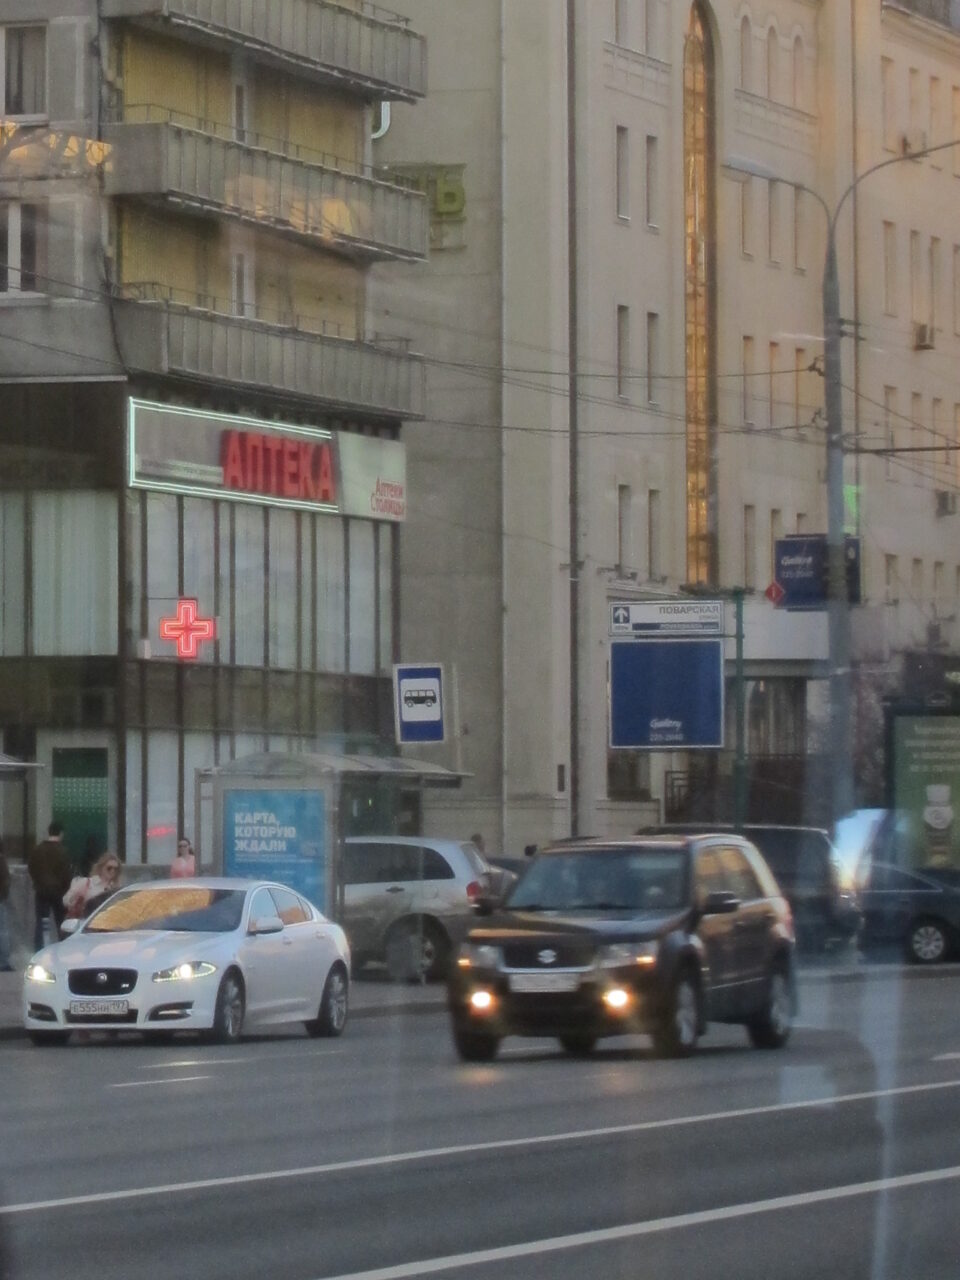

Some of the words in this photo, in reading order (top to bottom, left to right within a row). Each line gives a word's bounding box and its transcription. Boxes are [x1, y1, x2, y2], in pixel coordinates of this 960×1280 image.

[225, 431, 335, 500] АПТЕКА
[659, 605, 720, 615] ПОВАРСКАЯ
[235, 813, 280, 827] КАРТА,
[235, 827, 296, 838] КОТОРУЮ
[235, 840, 286, 852] ЖДАЛИ
